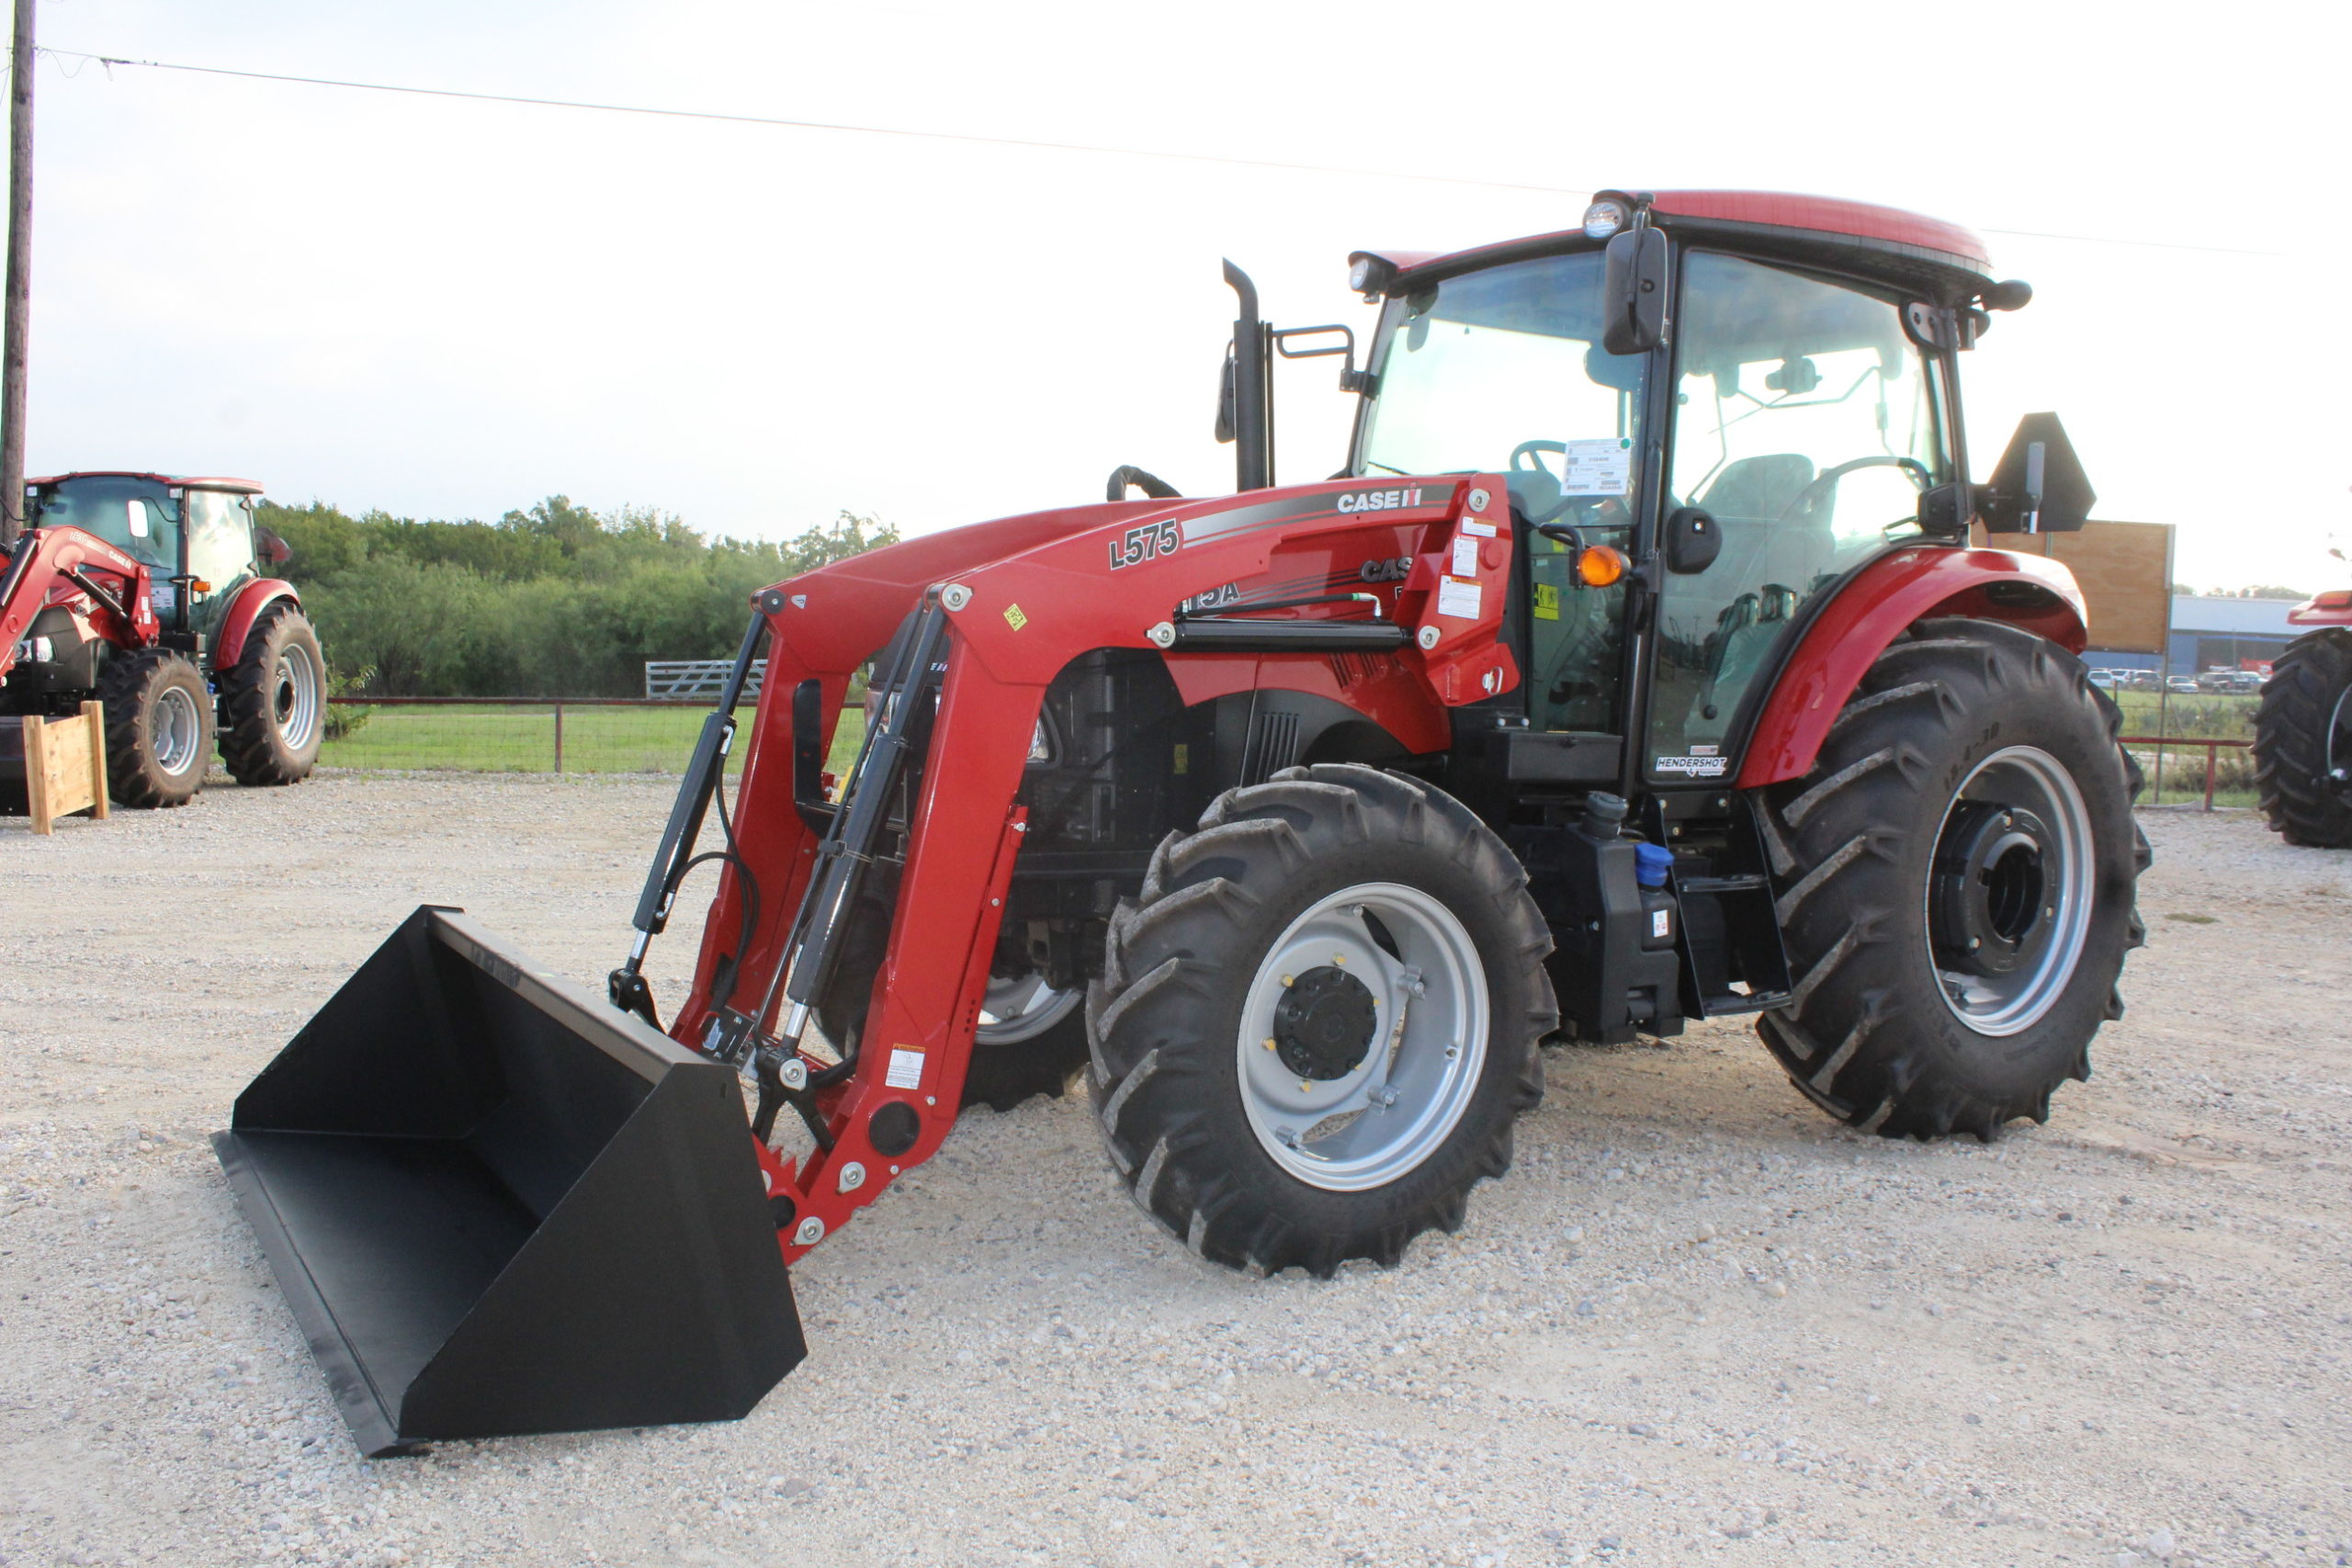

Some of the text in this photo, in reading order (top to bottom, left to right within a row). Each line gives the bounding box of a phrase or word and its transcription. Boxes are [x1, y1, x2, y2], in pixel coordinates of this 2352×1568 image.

[1338, 491, 1399, 513] CASE
[1109, 517, 1179, 570] L575
[1657, 758, 1726, 768] HENDERSHOT
